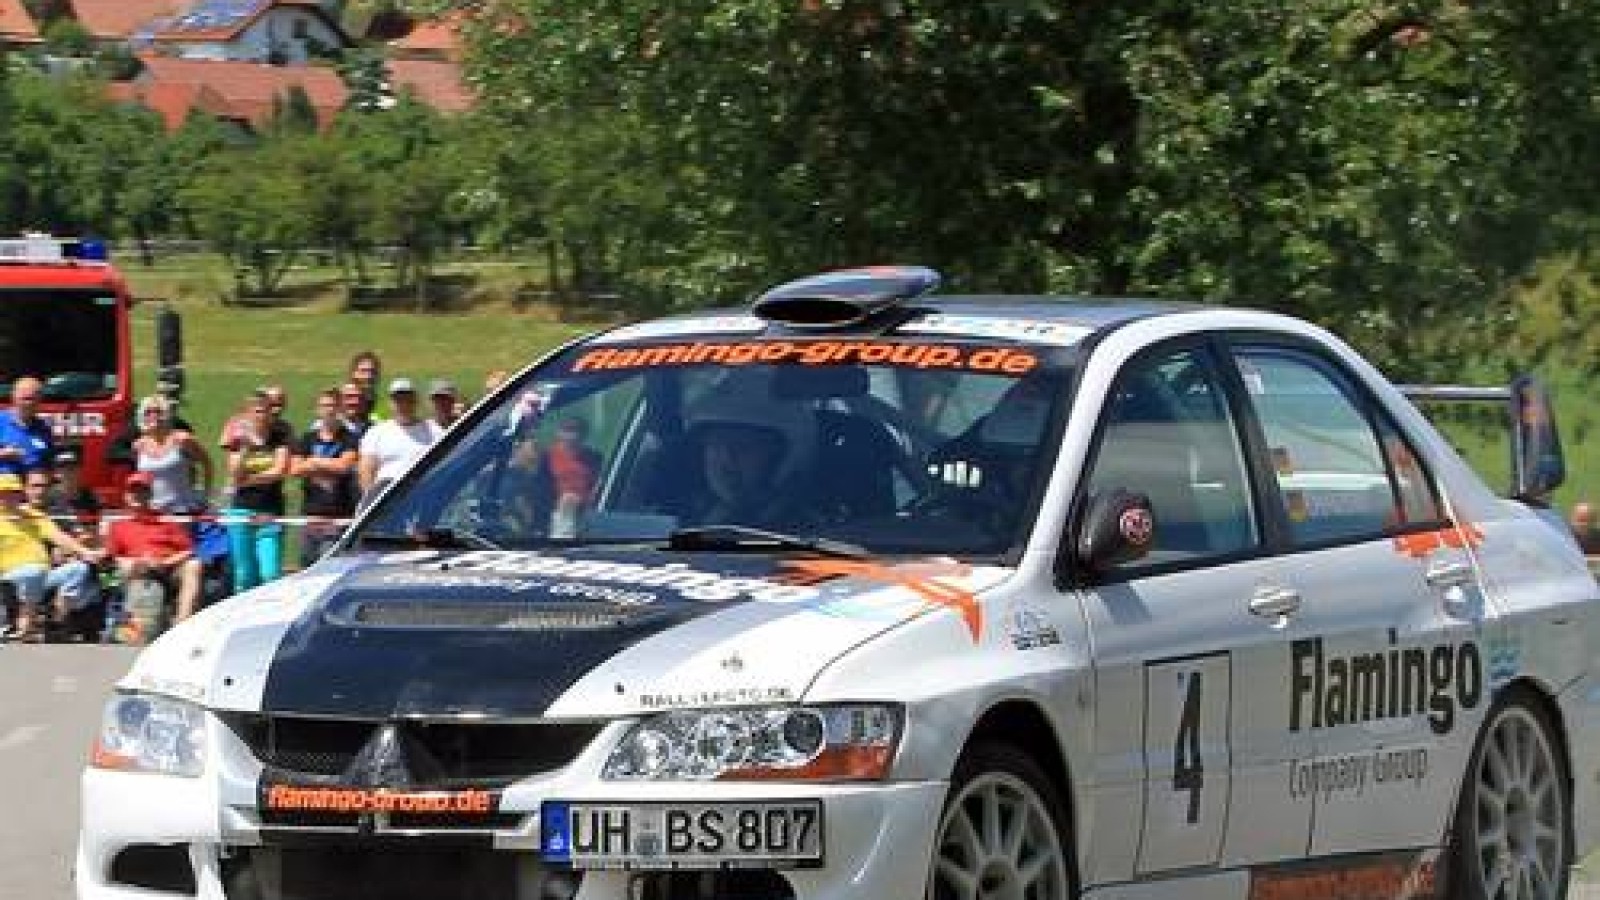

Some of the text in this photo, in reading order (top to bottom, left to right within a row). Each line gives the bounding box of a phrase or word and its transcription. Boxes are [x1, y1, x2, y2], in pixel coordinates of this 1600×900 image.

[573, 341, 1037, 375] flamingo-group.de
[1289, 627, 1482, 733] Flamingo
[1173, 671, 1203, 823] 4
[1288, 745, 1428, 803] Company Group
[571, 805, 816, 854] UH BS 807
